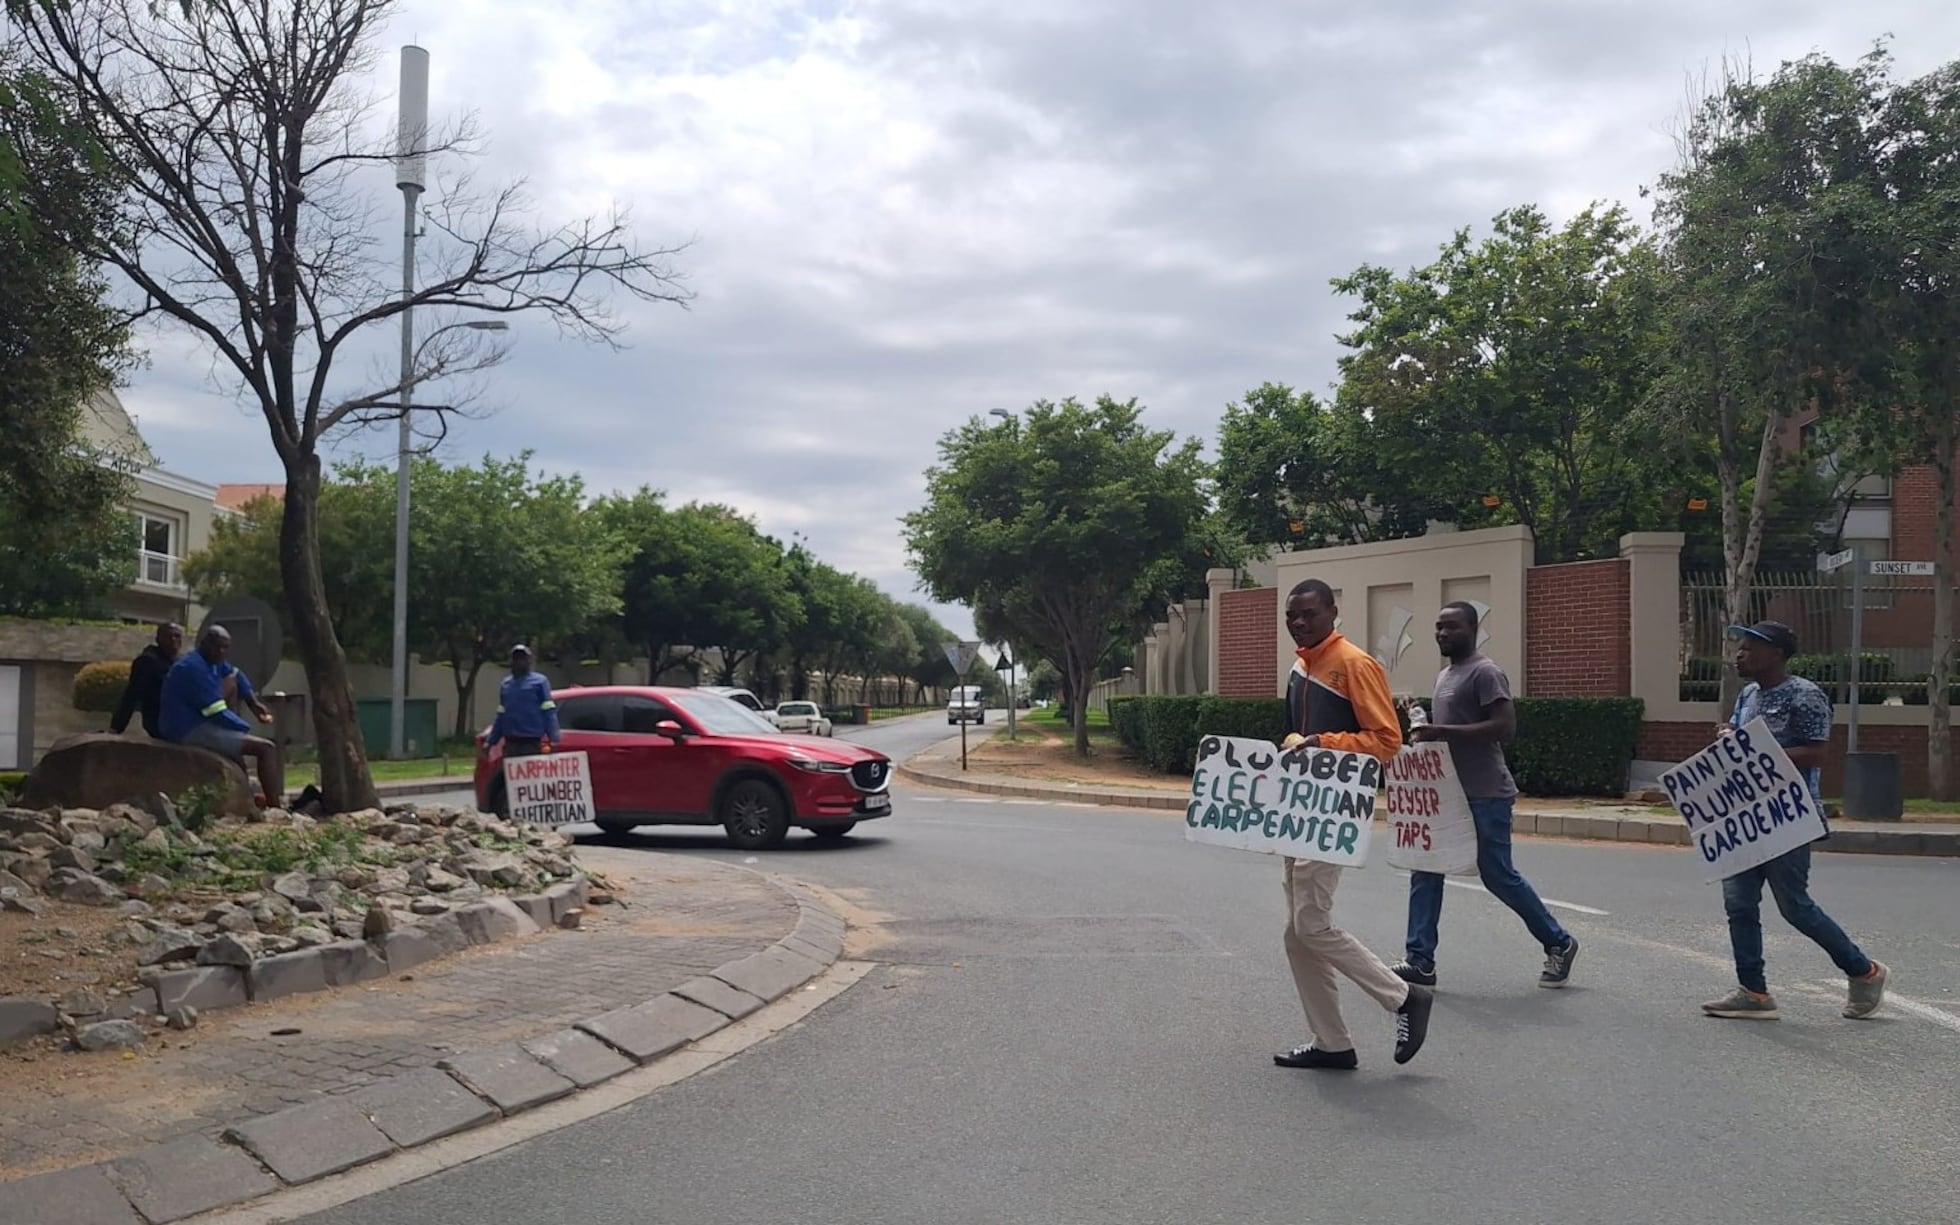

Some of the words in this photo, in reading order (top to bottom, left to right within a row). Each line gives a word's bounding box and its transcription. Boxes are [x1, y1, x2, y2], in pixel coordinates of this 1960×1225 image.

[1874, 562, 1912, 574] SUNSET
[507, 757, 580, 780] CARPENTER
[1200, 735, 1379, 789] PLUMBER
[1384, 749, 1445, 782] PLUMBER
[1663, 729, 1757, 801] PAINTER
[517, 780, 583, 803] PLUMBER
[1387, 784, 1439, 816] GEYSER
[1679, 753, 1785, 829] PLUMBER
[1186, 800, 1359, 855] CARPENTER
[1395, 821, 1431, 851] TAPS
[1700, 781, 1809, 862] GARDENER
